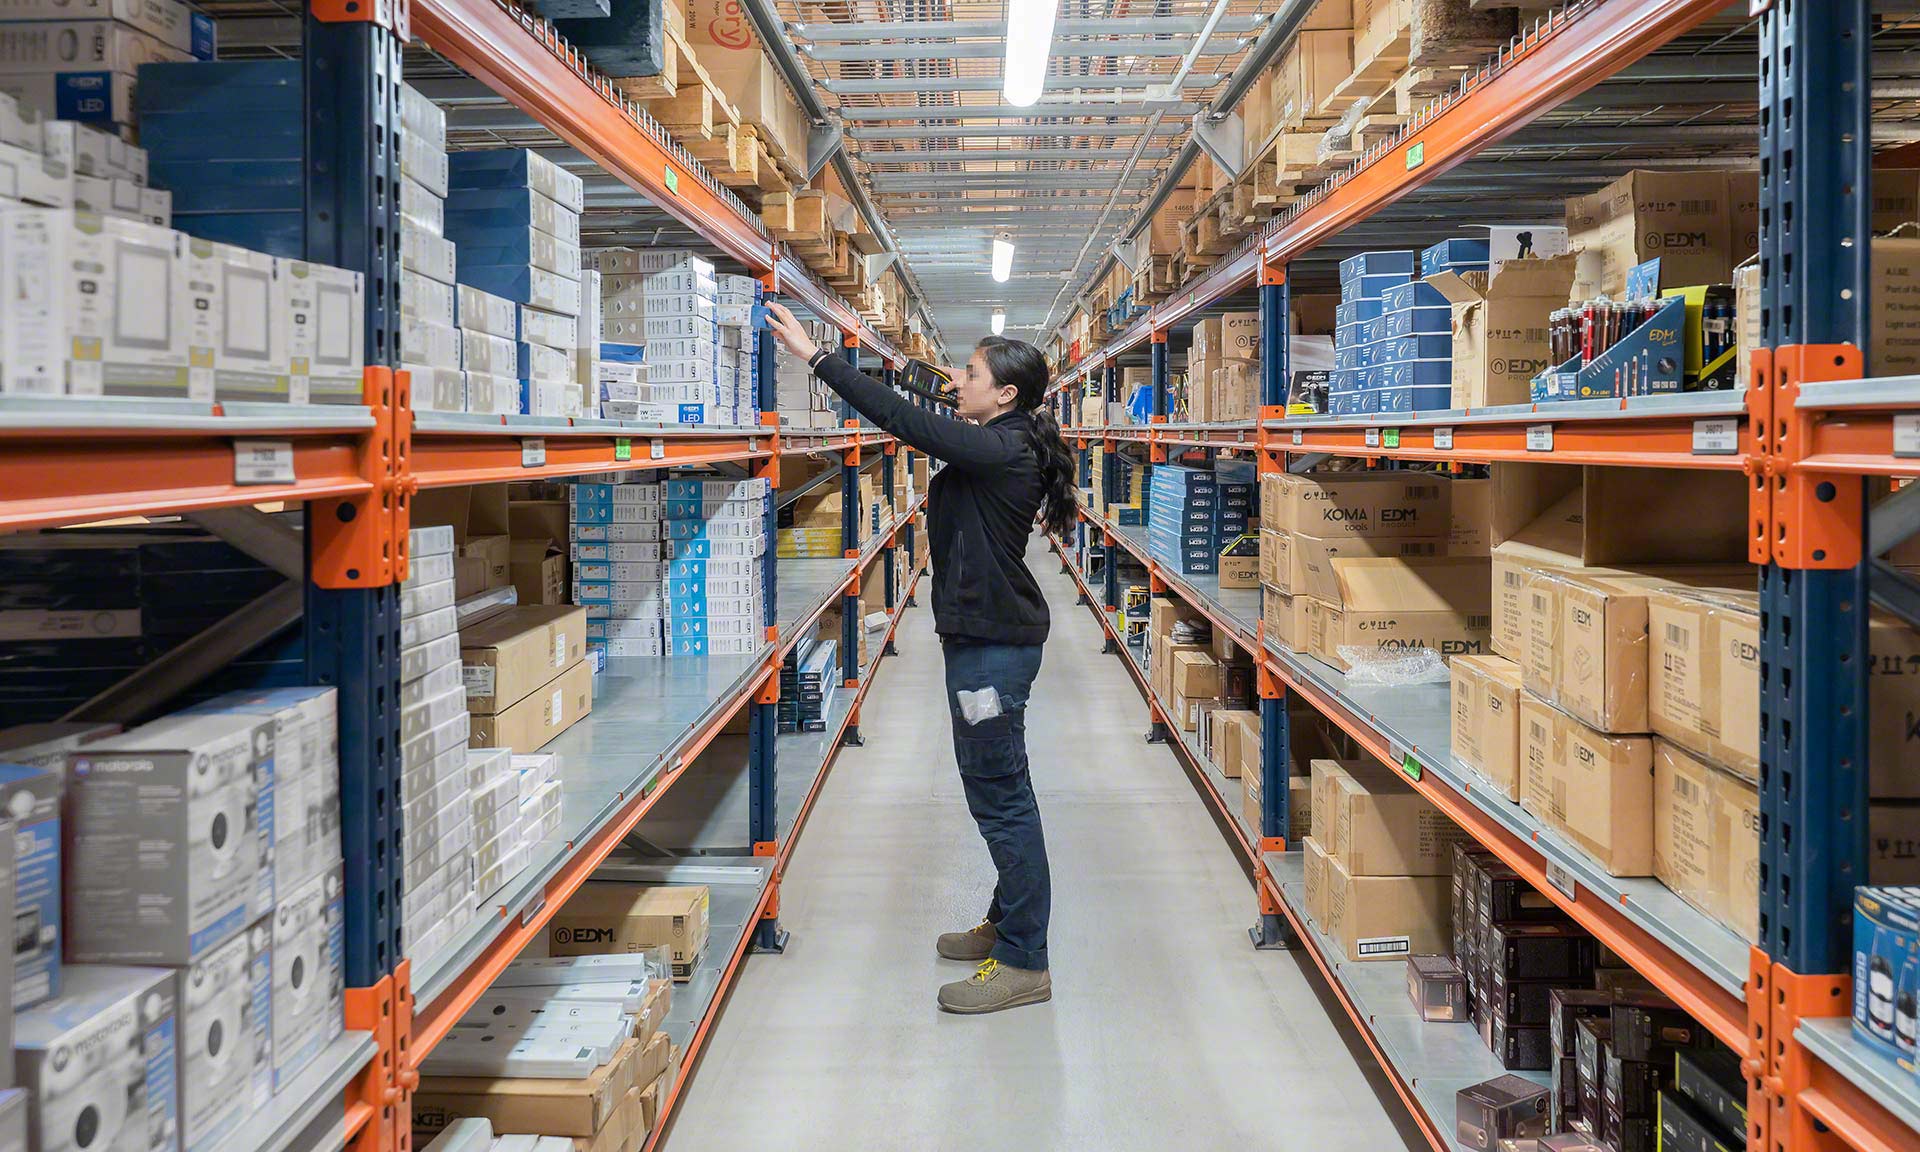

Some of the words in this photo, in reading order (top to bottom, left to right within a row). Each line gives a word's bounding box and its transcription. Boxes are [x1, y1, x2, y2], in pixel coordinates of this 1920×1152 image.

[78, 99, 104, 112] LED
[1664, 232, 1706, 247] EDM
[1650, 329, 1675, 341] EDM
[1508, 359, 1548, 373] EDM
[683, 414, 700, 422] LED
[1323, 508, 1367, 521] KOMA
[1381, 508, 1417, 521] EDM
[1344, 523, 1368, 532] tools
[1577, 609, 1592, 627] EDM
[1378, 639, 1425, 652] KOMA
[1441, 641, 1480, 654] EDM
[1580, 746, 1595, 766] EDM
[96, 760, 154, 772] motorola
[574, 928, 613, 942] EDM
